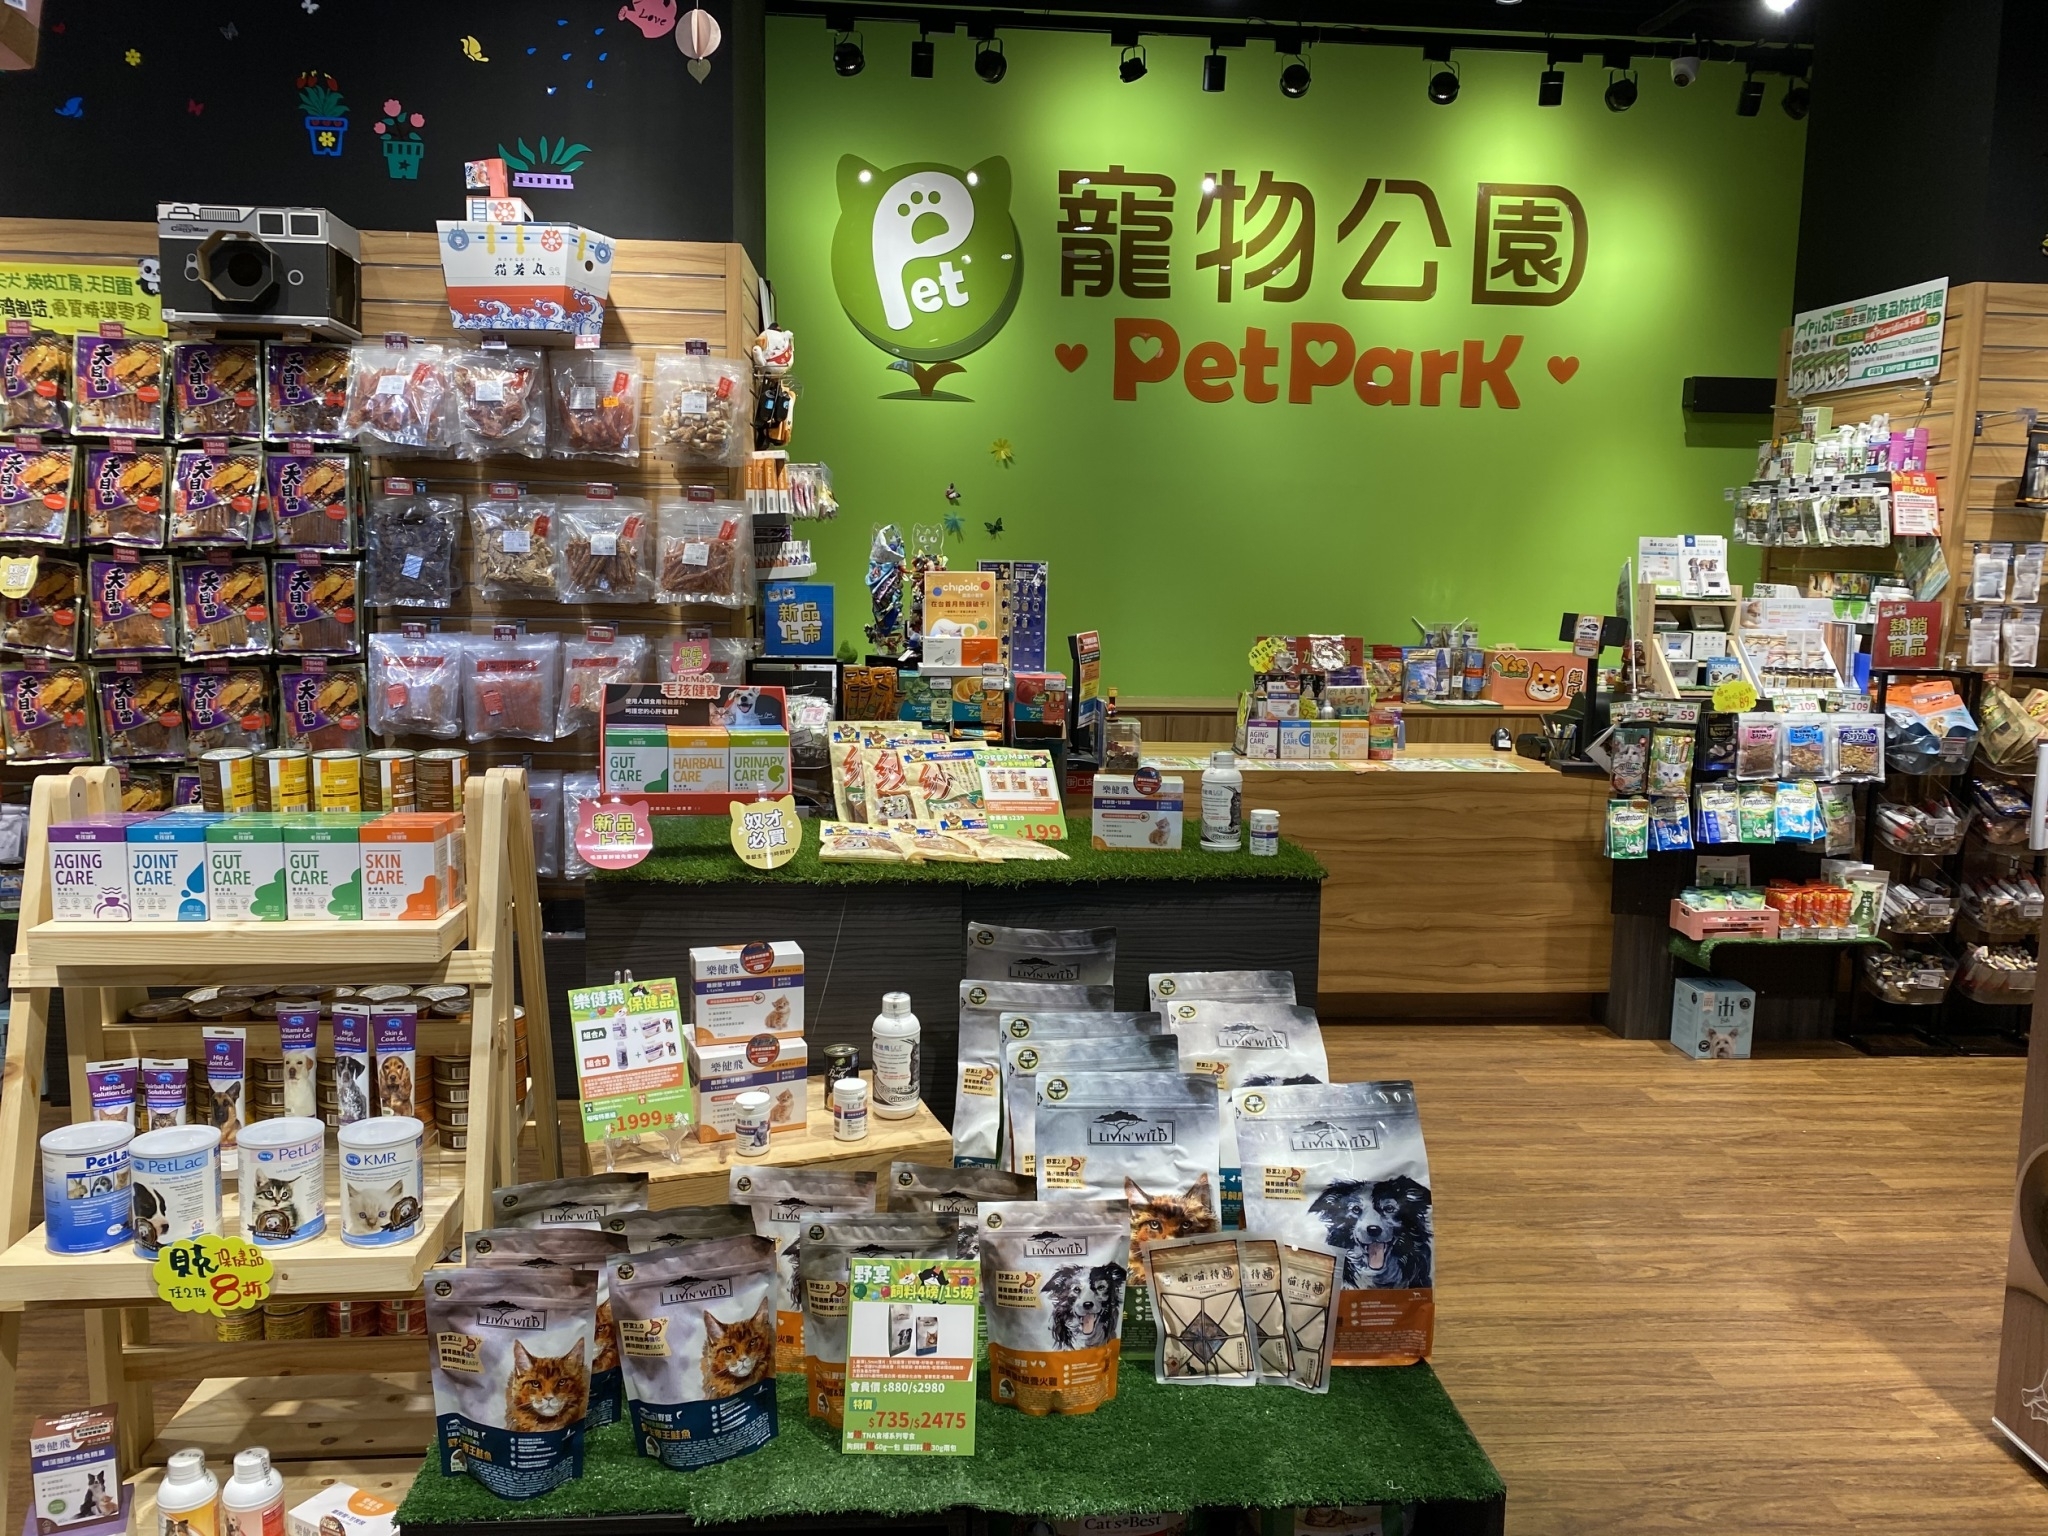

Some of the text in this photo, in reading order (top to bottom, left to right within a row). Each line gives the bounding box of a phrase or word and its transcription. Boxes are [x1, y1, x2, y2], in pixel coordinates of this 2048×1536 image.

[1056, 165, 1588, 307] 寵物公園
[1808, 319, 1835, 337] Pilou
[942, 582, 980, 595] chipolo
[779, 602, 820, 622] 新品
[780, 623, 821, 644] 上市
[1890, 617, 1928, 636] 熱銷
[680, 646, 703, 659] 新品
[1889, 637, 1927, 657] 商品
[662, 684, 721, 698] 毛孩健寶
[610, 756, 636, 769] GUT
[673, 757, 725, 769] HAIRBALL
[734, 756, 784, 769] URINARY
[976, 752, 1031, 761] DoggyMan
[610, 769, 642, 782] CARE
[673, 770, 702, 783] CARE
[734, 769, 765, 782] CARE
[1102, 784, 1130, 795] 樂健飛
[1706, 797, 1735, 806] Temptations
[1742, 797, 1772, 806] Temptations
[593, 815, 635, 832] 新品
[745, 810, 783, 831] 奴才
[1614, 813, 1645, 823] Temptations
[748, 829, 787, 849] 必買
[1016, 824, 1062, 840] $199
[54, 854, 102, 869] AGING
[133, 854, 178, 869] JOINT
[212, 854, 242, 869] GUT
[290, 854, 319, 869] GUT
[366, 854, 401, 869] SKIN
[55, 870, 94, 885] CARE
[134, 870, 173, 885] CARE
[213, 870, 251, 885] CARE
[290, 870, 328, 885] CARE
[366, 870, 404, 885] CARE
[706, 963, 740, 976] 樂健飛
[1046, 969, 1074, 979] WILD
[573, 988, 675, 1013] 樂健飛 保健品
[583, 1030, 605, 1040] 組合A
[1254, 1038, 1283, 1047] WILD
[212, 1054, 224, 1062] Hip
[586, 1059, 608, 1069] 組合B
[710, 1059, 744, 1073] 樂健飛
[92, 1087, 133, 1098] Solution Gel
[1135, 1131, 1167, 1142] WILD
[278, 1140, 322, 1161] PetLac
[148, 1156, 204, 1173] PetLac
[363, 1151, 397, 1166] KMR
[577, 1211, 600, 1221] WILD
[1057, 1246, 1083, 1255] WILD
[854, 1265, 890, 1284] 野宴
[700, 1287, 727, 1300] WILD
[890, 1284, 974, 1301] 飼料4磅/15磅
[513, 1316, 540, 1328] WILD
[850, 1381, 946, 1395] 會員價 $880/$2980
[853, 1399, 873, 1410] 特價
[868, 1411, 966, 1430] $735/$2475
[34, 1439, 71, 1453] 樂健飛
[1084, 1514, 1162, 1531] Cat's Best
